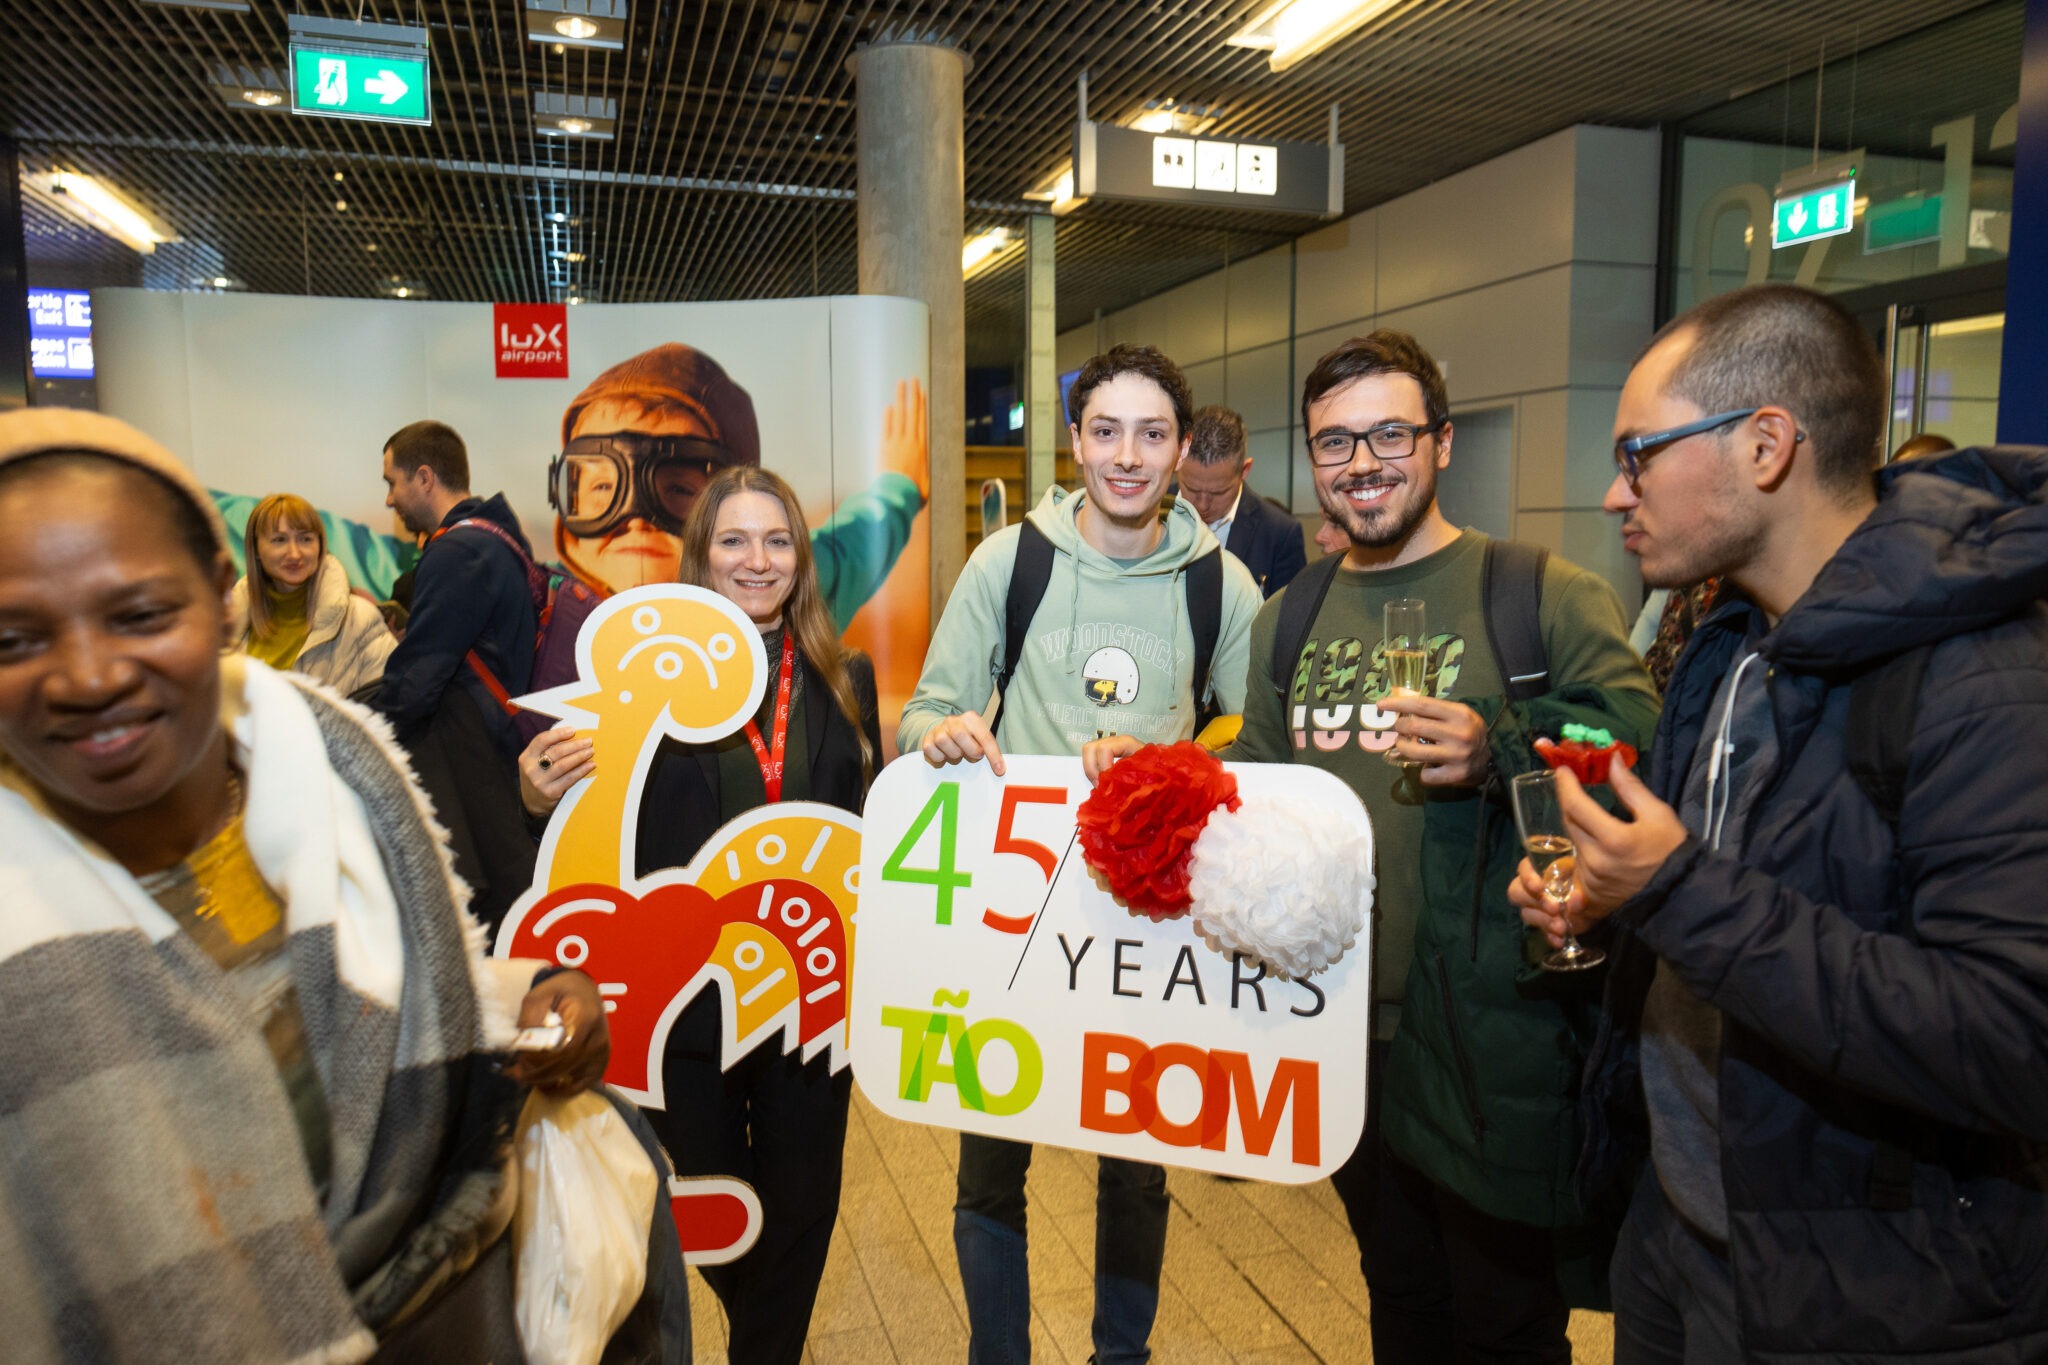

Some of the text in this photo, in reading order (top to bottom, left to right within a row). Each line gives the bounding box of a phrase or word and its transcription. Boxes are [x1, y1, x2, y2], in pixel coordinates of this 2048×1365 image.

[501, 322, 562, 349] lux
[501, 349, 563, 364] airport
[882, 781, 1068, 934] 45
[1057, 933, 1326, 1017] YEARS
[881, 988, 1320, 1167] TÃO BOM
